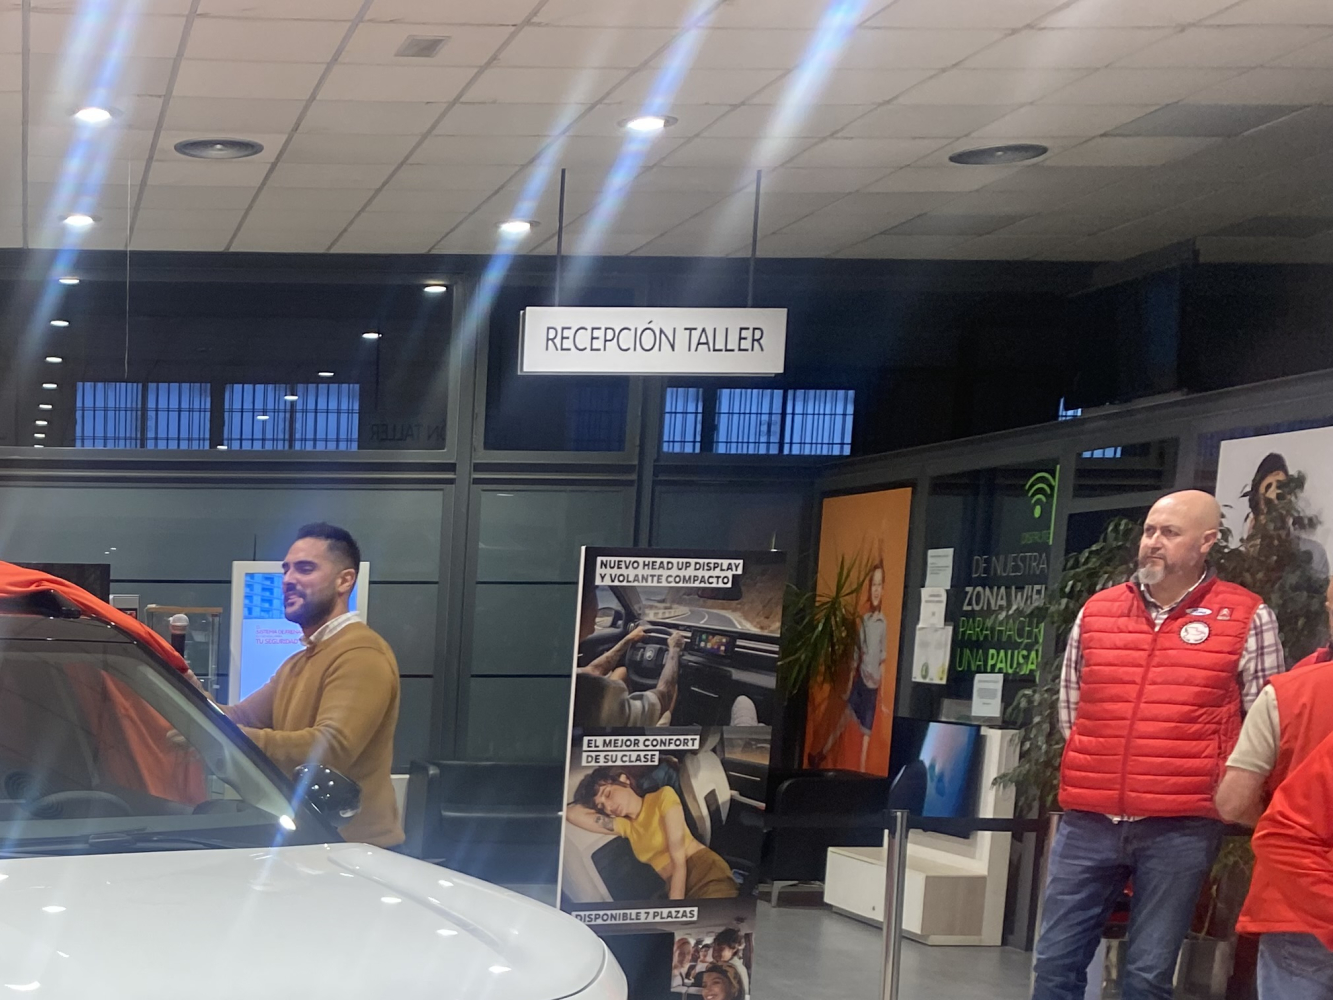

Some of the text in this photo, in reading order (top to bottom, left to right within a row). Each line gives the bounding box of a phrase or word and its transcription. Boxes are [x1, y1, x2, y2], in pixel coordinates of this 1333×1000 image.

[545, 320, 765, 353] RECEPCIÓN TALLER
[599, 559, 741, 572] NUEVO HEAD UP DISPLAY
[972, 555, 989, 577] DE
[991, 552, 1048, 577] NUESTRA
[599, 573, 730, 585] Y VOLANTE COMPACTO
[962, 585, 1007, 611] ZONA
[959, 617, 991, 641] PARA
[956, 647, 1037, 675] UNA PAUSA
[587, 737, 697, 749] EL MEJOR CONFORT
[586, 753, 656, 764] DE SU CLASE
[575, 909, 696, 923] DISPONIBLE 7 PLAZAS
